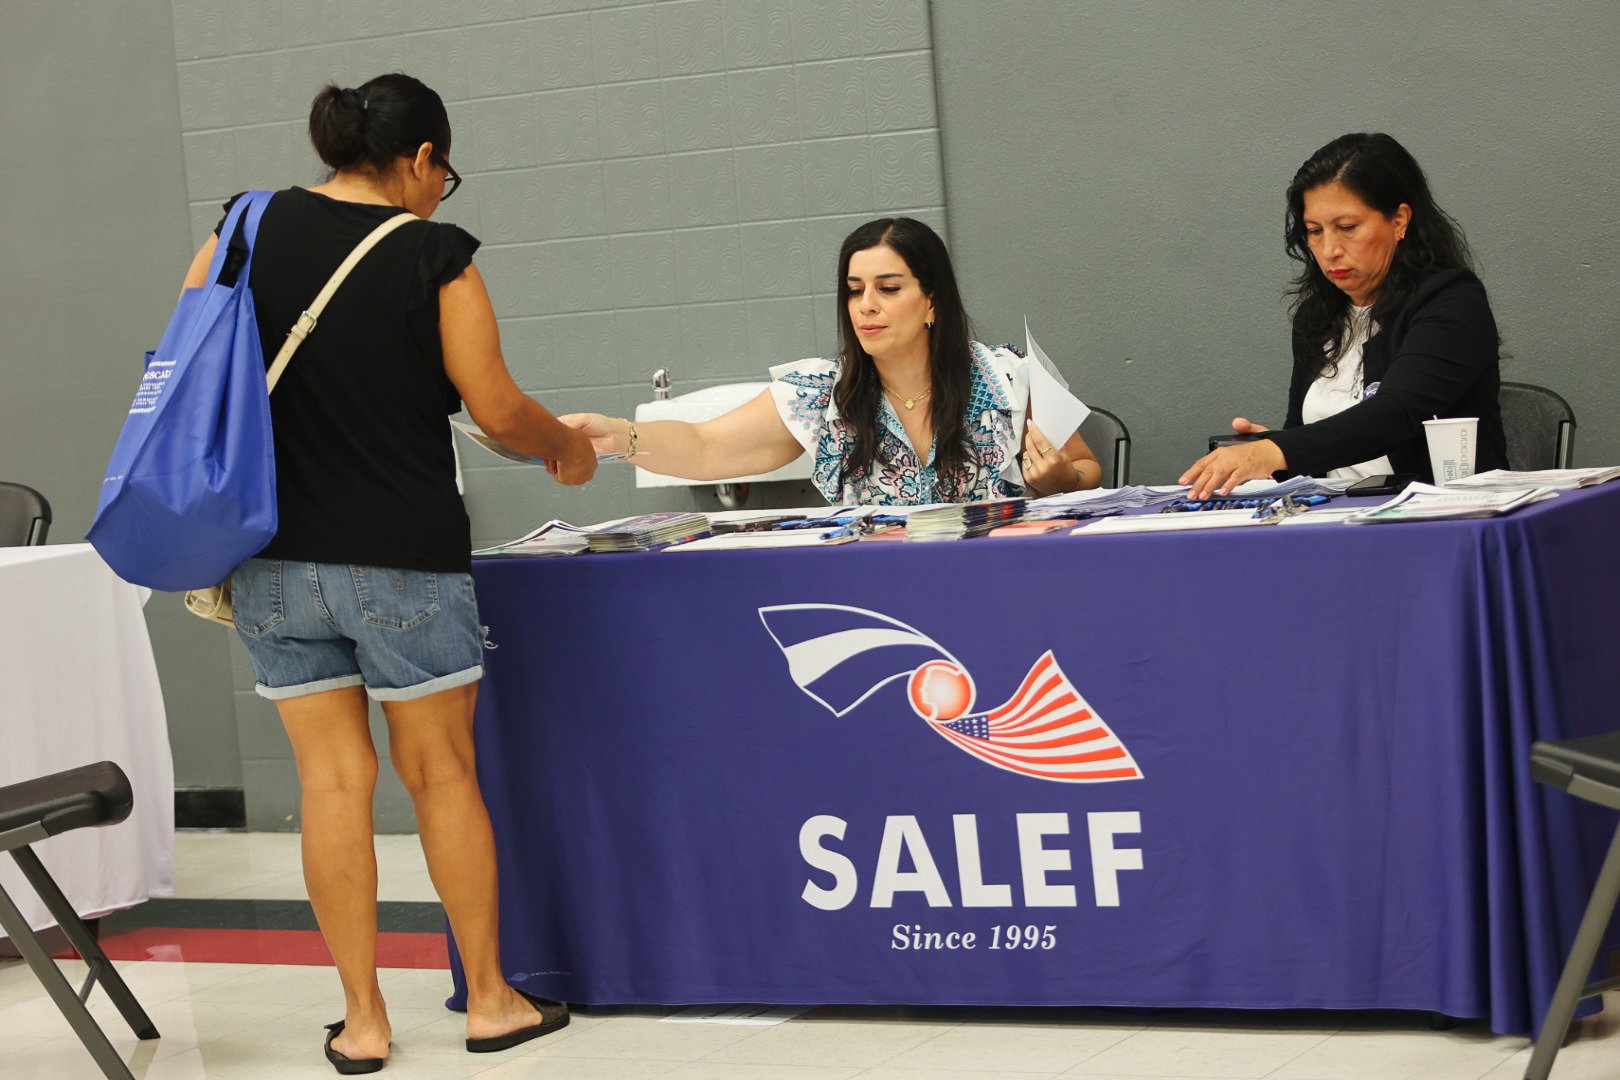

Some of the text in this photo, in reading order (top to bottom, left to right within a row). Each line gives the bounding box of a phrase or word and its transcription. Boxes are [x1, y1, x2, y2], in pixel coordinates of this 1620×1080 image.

[799, 811, 1144, 910] SALEF
[891, 924, 1058, 951] Since 1995
